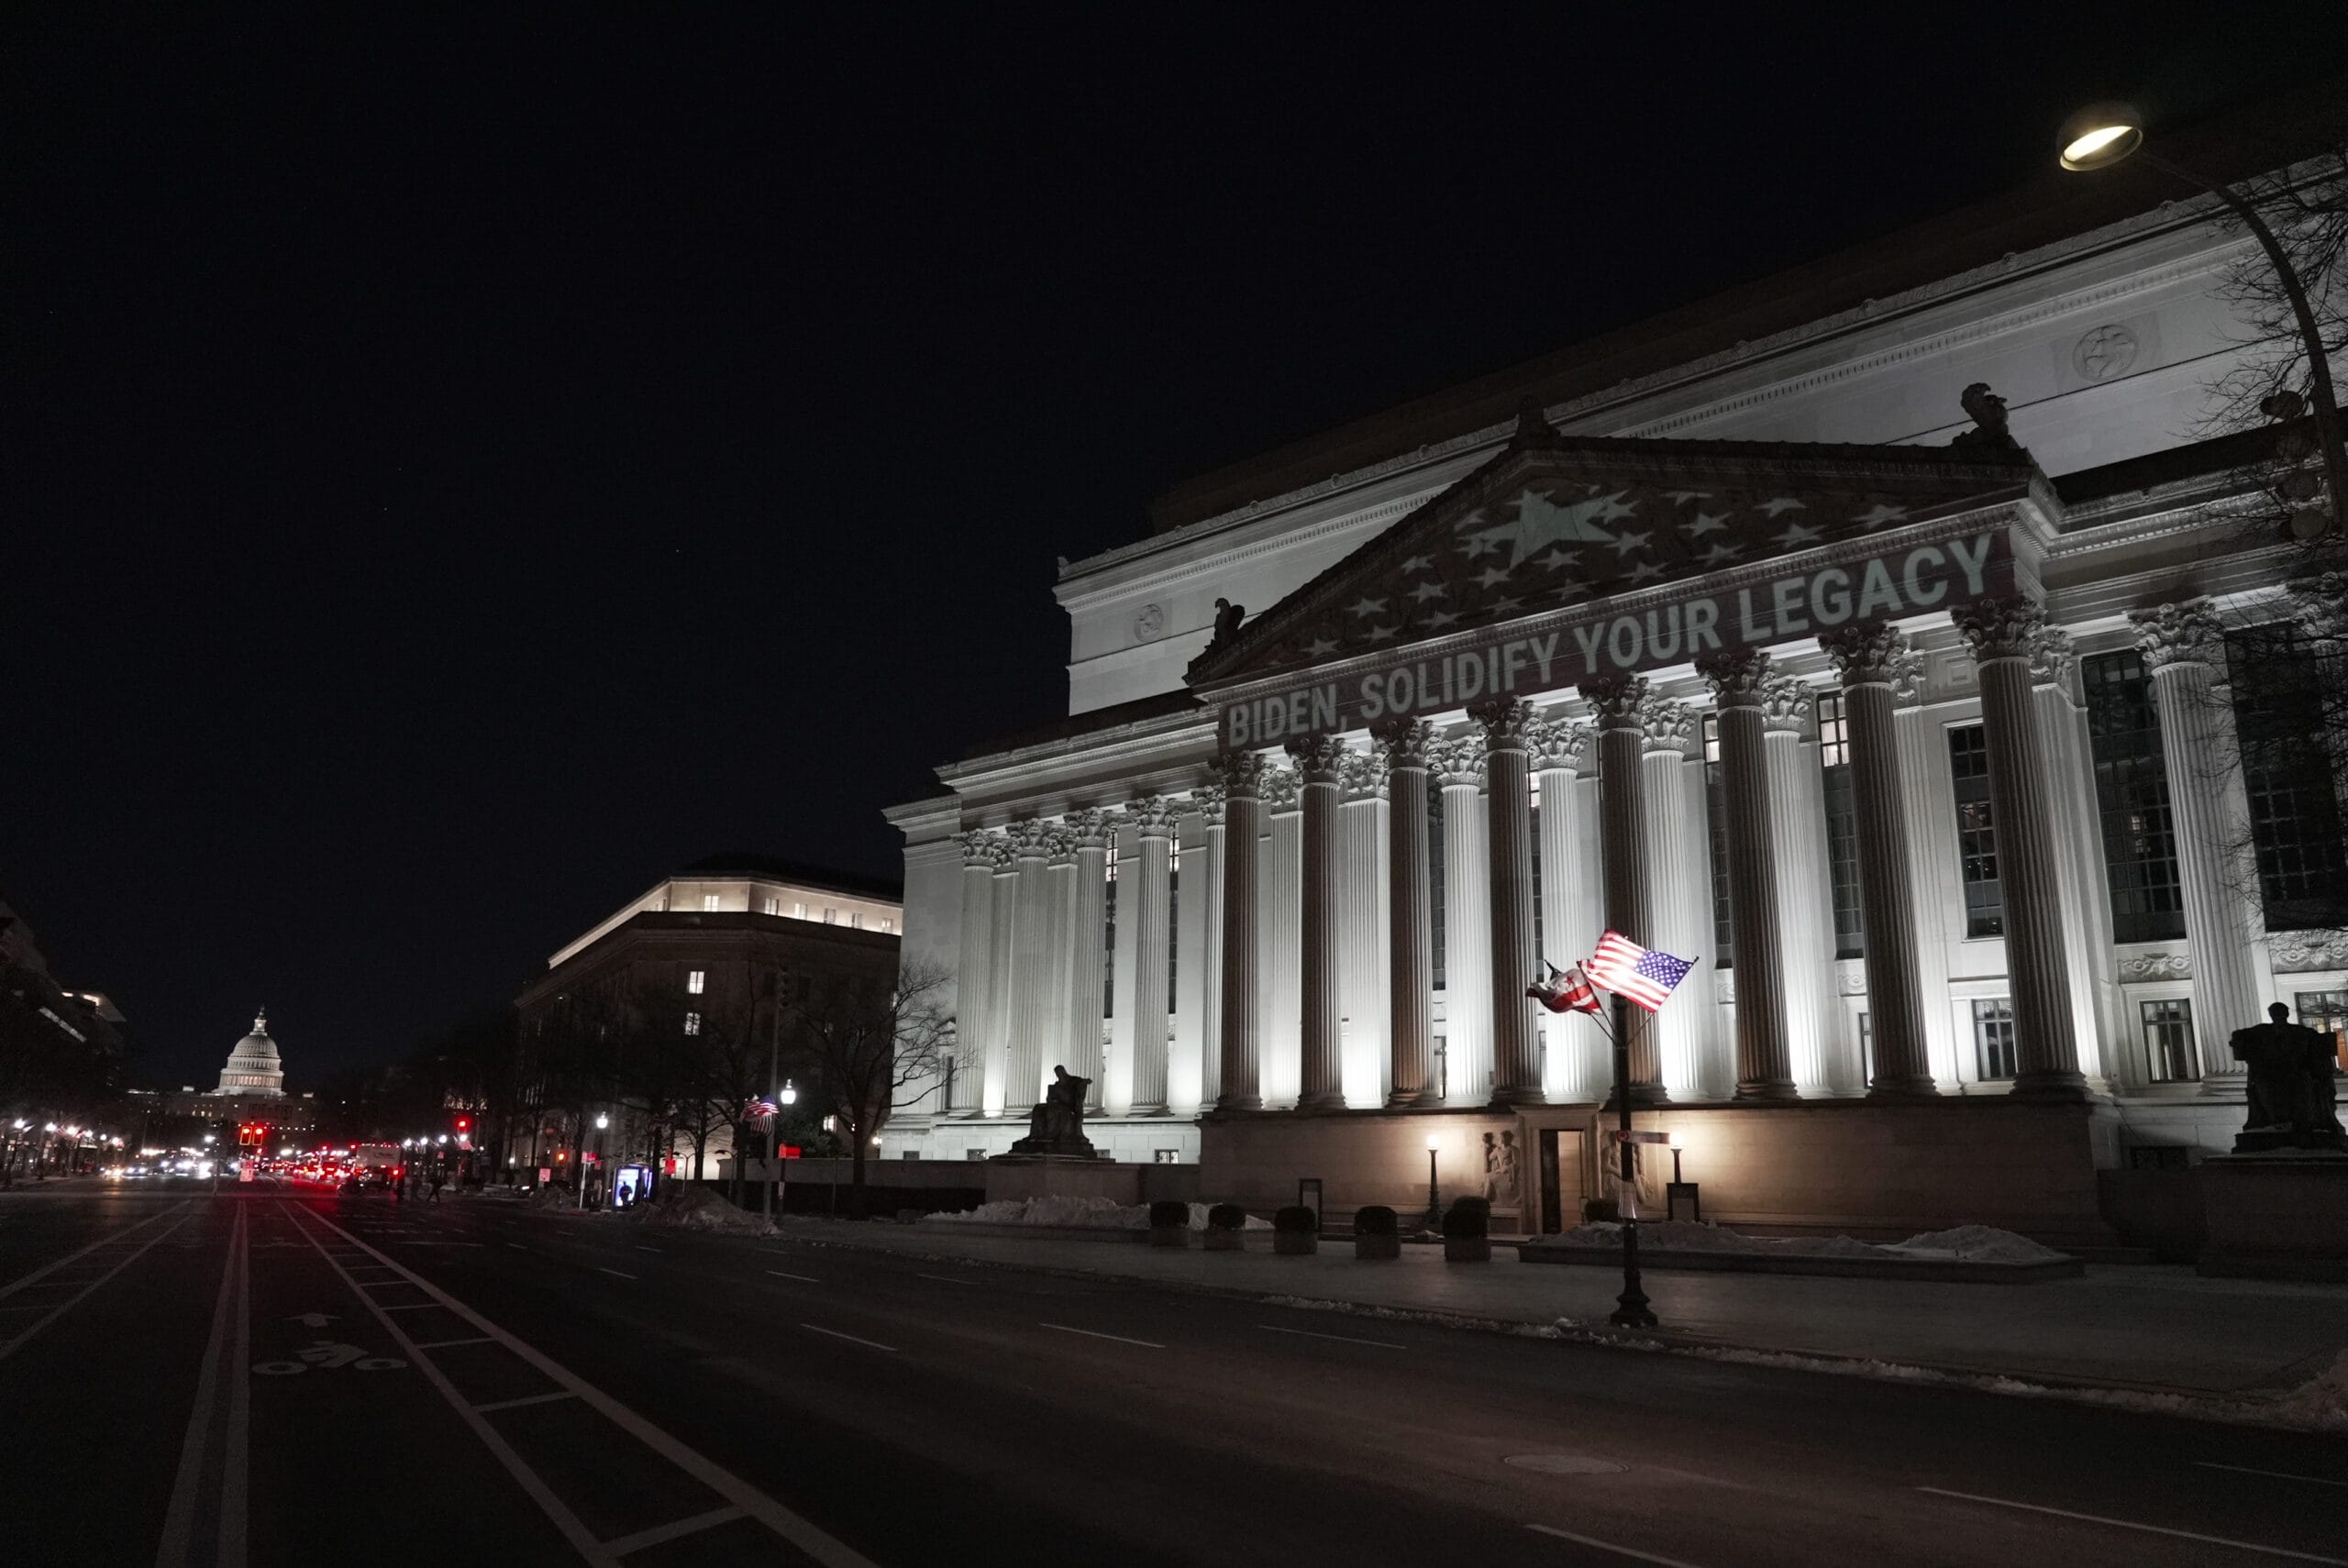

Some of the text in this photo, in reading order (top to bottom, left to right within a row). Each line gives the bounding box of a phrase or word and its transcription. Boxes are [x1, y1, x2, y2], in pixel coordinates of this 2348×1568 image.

[1228, 535, 1992, 747] BIDEN, SOLIDIFY YOUR LEGACY
